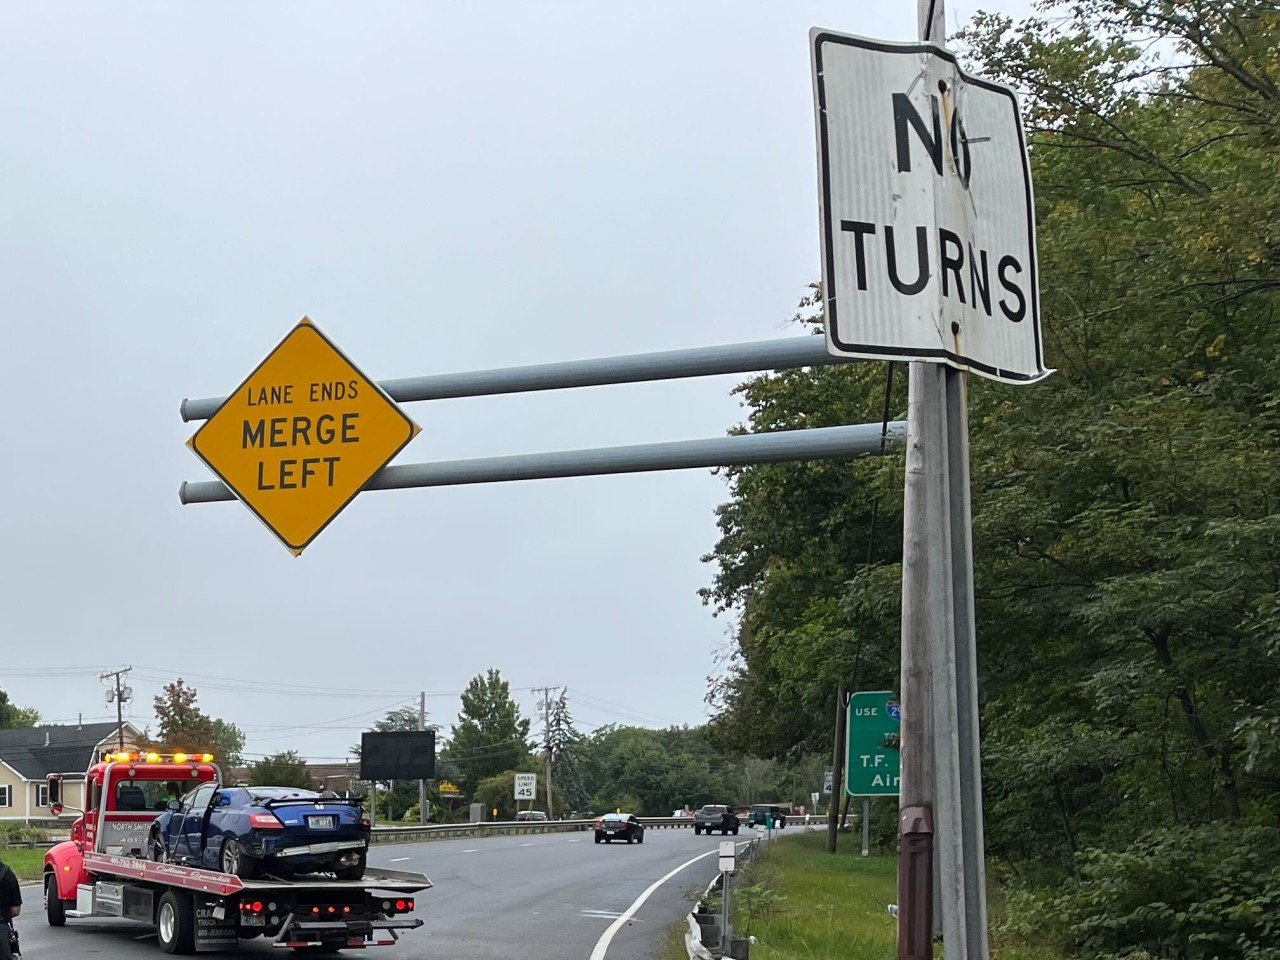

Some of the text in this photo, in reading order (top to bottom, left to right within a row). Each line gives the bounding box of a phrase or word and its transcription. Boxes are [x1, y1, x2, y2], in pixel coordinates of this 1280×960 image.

[892, 93, 971, 190] NO
[840, 219, 1027, 323] TURNS
[247, 380, 359, 406] LANE ENDS
[241, 412, 360, 449] MERGE
[257, 456, 341, 490] LEFT
[855, 707, 878, 716] USE
[891, 706, 901, 716] 29
[860, 754, 889, 768] T.F.
[871, 773, 900, 787] Air
[518, 788, 532, 797] 45
